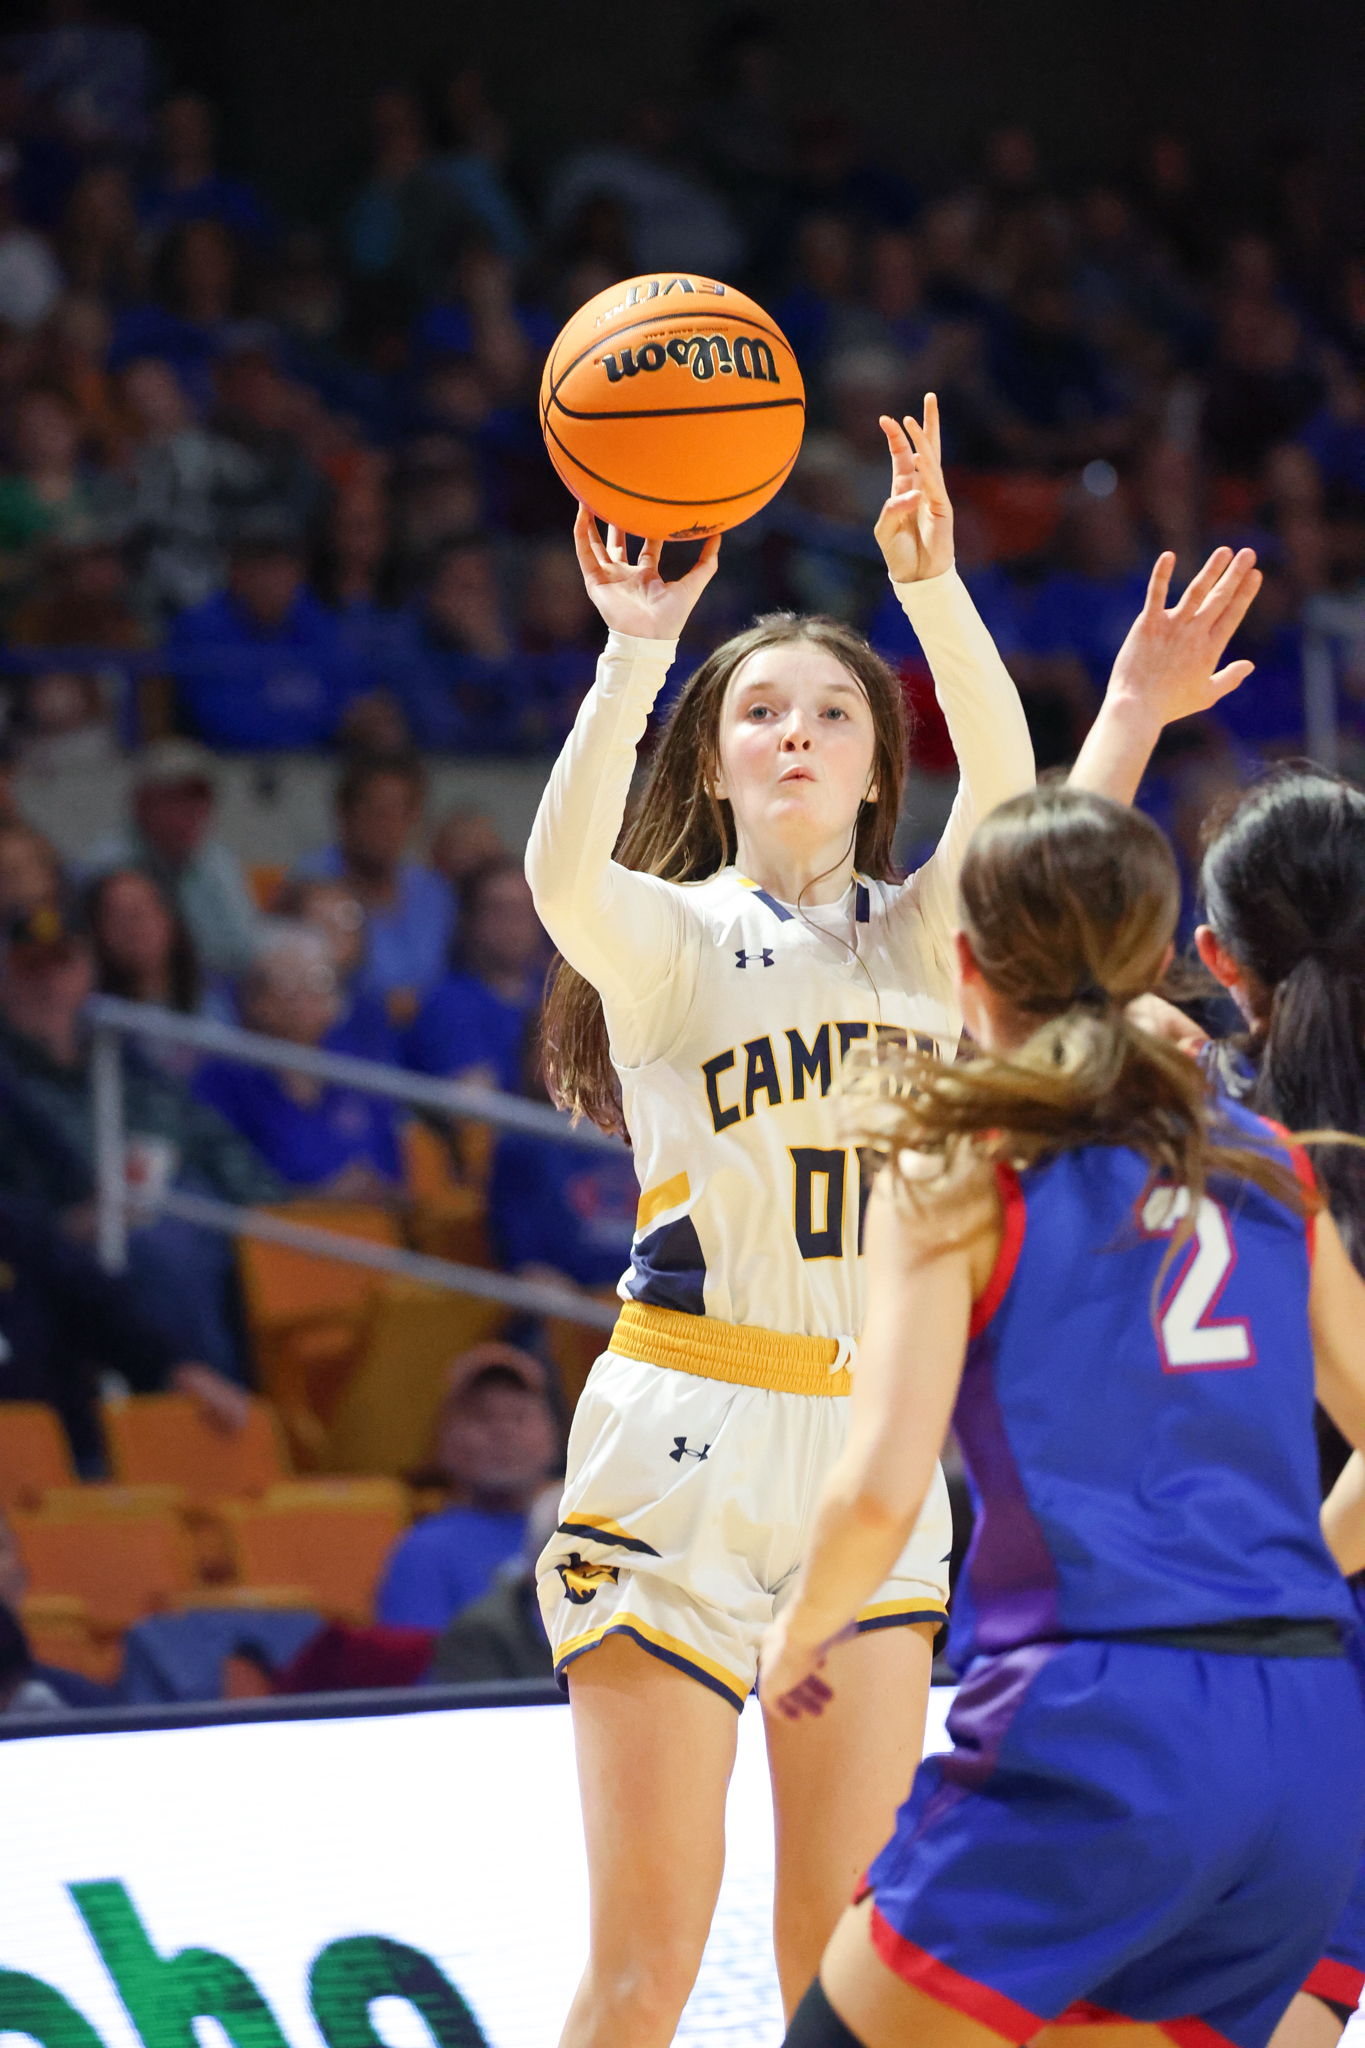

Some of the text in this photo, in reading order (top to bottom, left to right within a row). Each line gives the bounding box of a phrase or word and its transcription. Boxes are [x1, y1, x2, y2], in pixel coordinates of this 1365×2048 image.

[626, 278, 726, 309] EVO
[601, 333, 780, 384] Wilson
[700, 1020, 942, 1136] CAME
[786, 1144, 889, 1263] 0
[1133, 1180, 1259, 1375] 2
